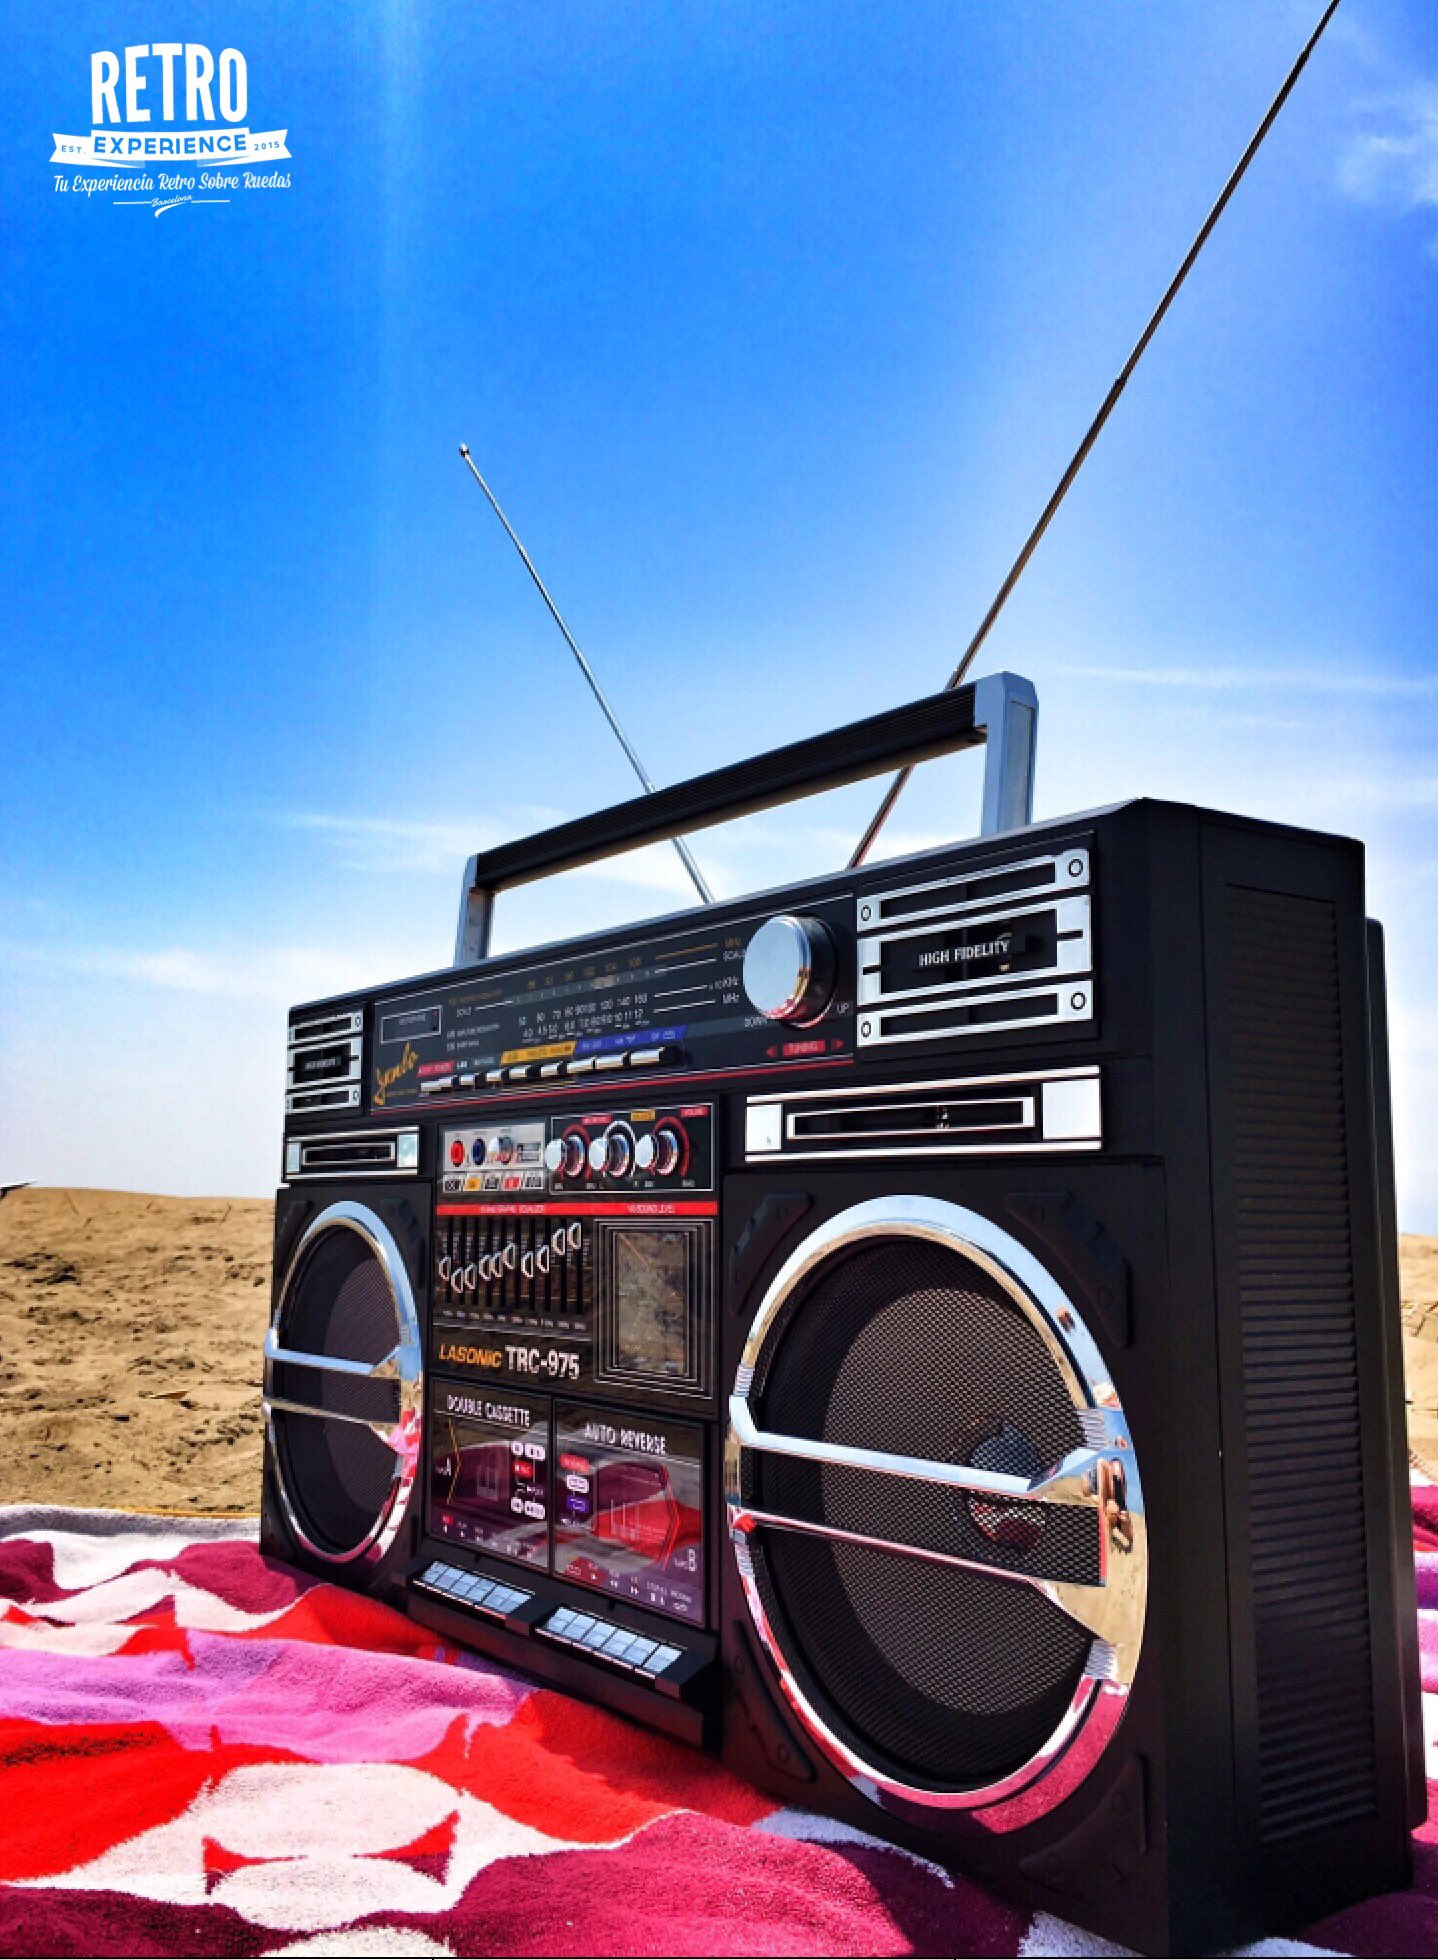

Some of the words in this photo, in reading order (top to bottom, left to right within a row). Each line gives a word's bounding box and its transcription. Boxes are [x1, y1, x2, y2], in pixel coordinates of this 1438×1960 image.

[919, 949, 950, 967] HIGH
[955, 940, 1009, 962] FIDELITY
[438, 1344, 502, 1368] LASONIC
[505, 1345, 580, 1379] TRC-975
[447, 1395, 482, 1416] DOUBLE
[485, 1403, 530, 1428] CASSETTE
[584, 1422, 616, 1444] AUTO
[620, 1428, 666, 1455] REVERSE
